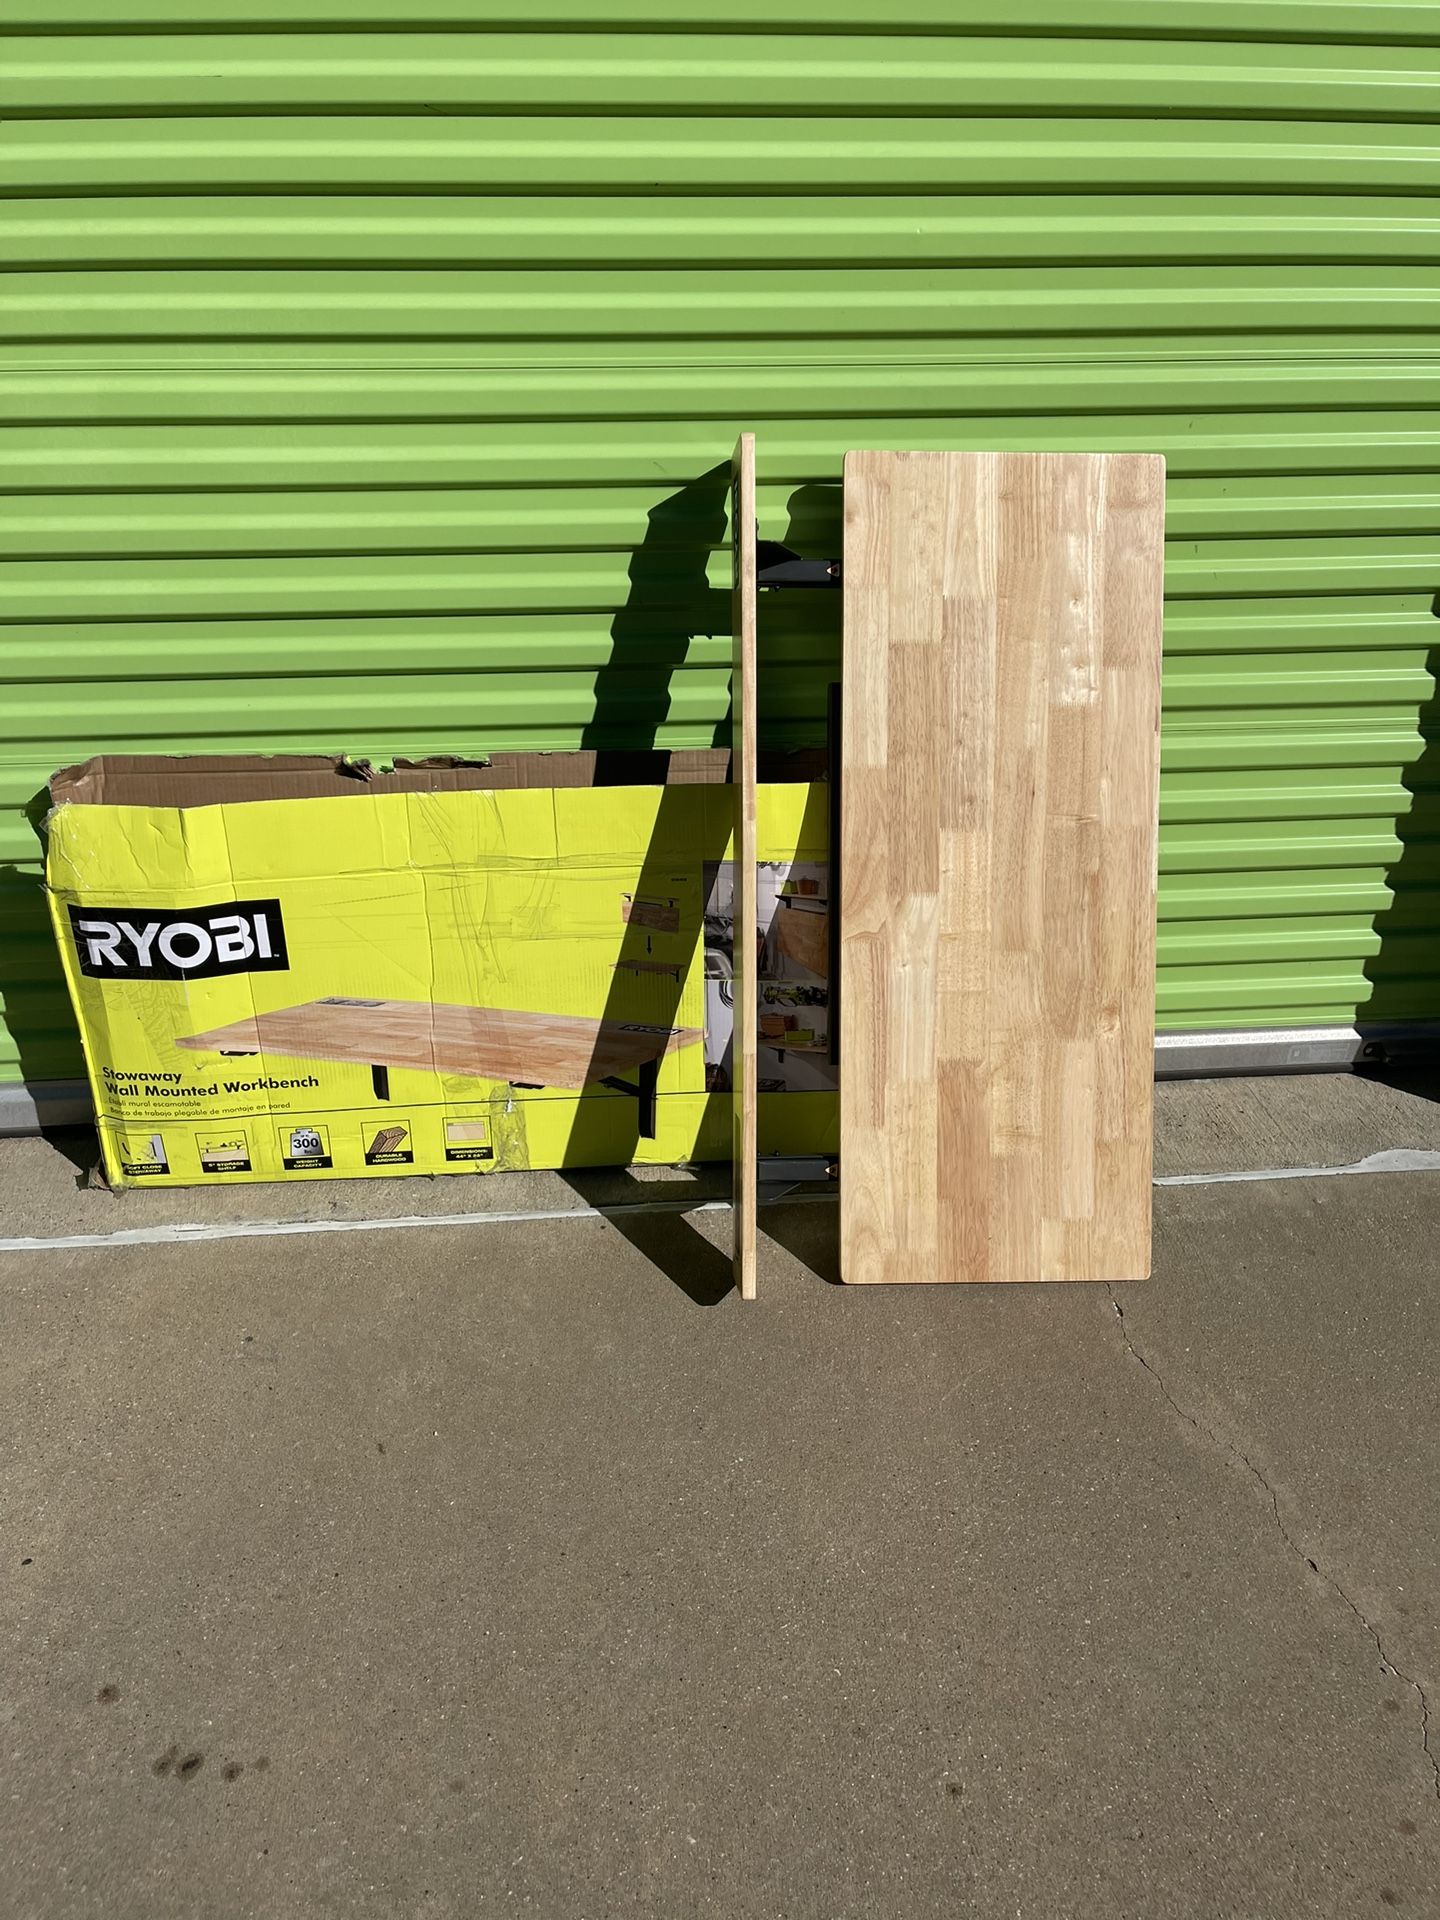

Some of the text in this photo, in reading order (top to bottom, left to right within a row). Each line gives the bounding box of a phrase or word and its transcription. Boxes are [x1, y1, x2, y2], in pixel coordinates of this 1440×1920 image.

[79, 913, 272, 969] RYOBI
[102, 1066, 182, 1084] Stowaway
[104, 1075, 319, 1097] Wall Mounted Workbench
[174, 1109, 207, 1117] plegable
[222, 1104, 254, 1113] montaje
[269, 1102, 290, 1110] pared
[293, 1137, 319, 1149] 300
